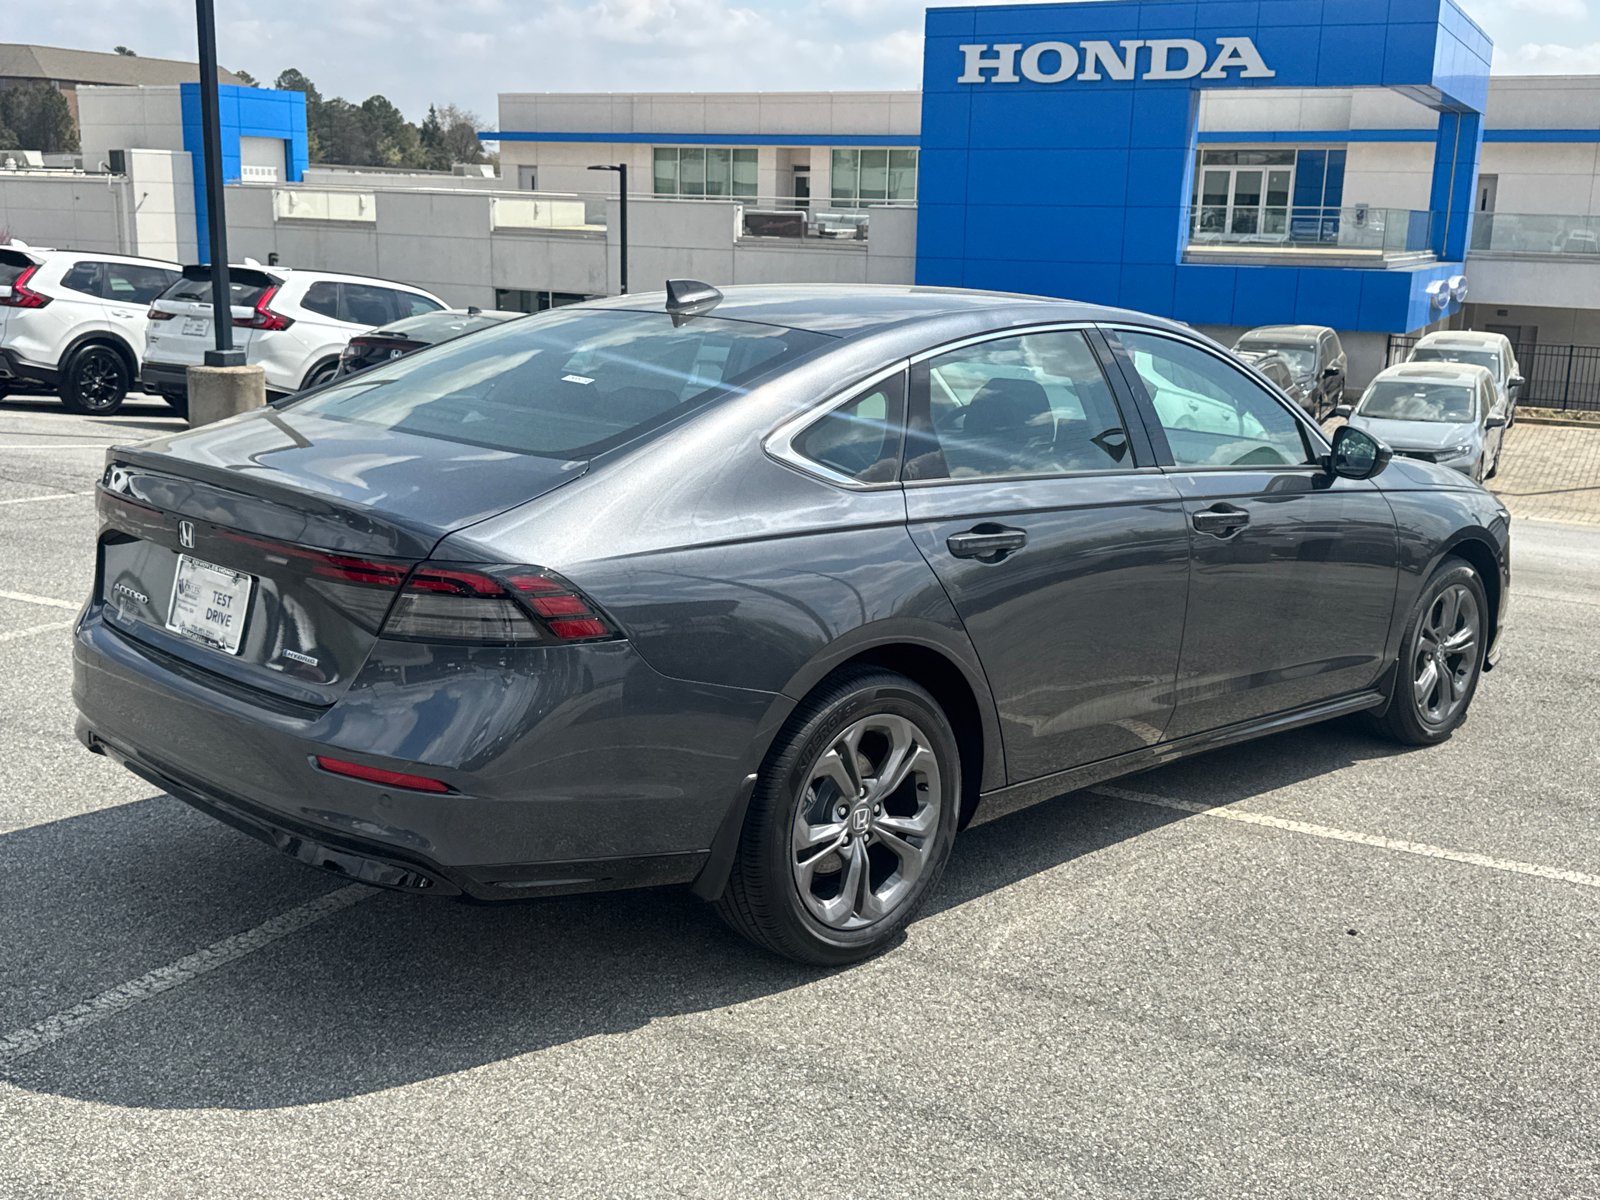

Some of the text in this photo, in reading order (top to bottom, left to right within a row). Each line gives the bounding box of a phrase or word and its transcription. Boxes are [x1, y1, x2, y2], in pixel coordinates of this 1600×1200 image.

[957, 37, 1276, 83] HONDA
[114, 583, 149, 604] ACCORD
[212, 591, 233, 608] TEST
[206, 607, 232, 628] DRIVE
[287, 652, 316, 664] HYBRID
[797, 709, 843, 775] KINERGY
